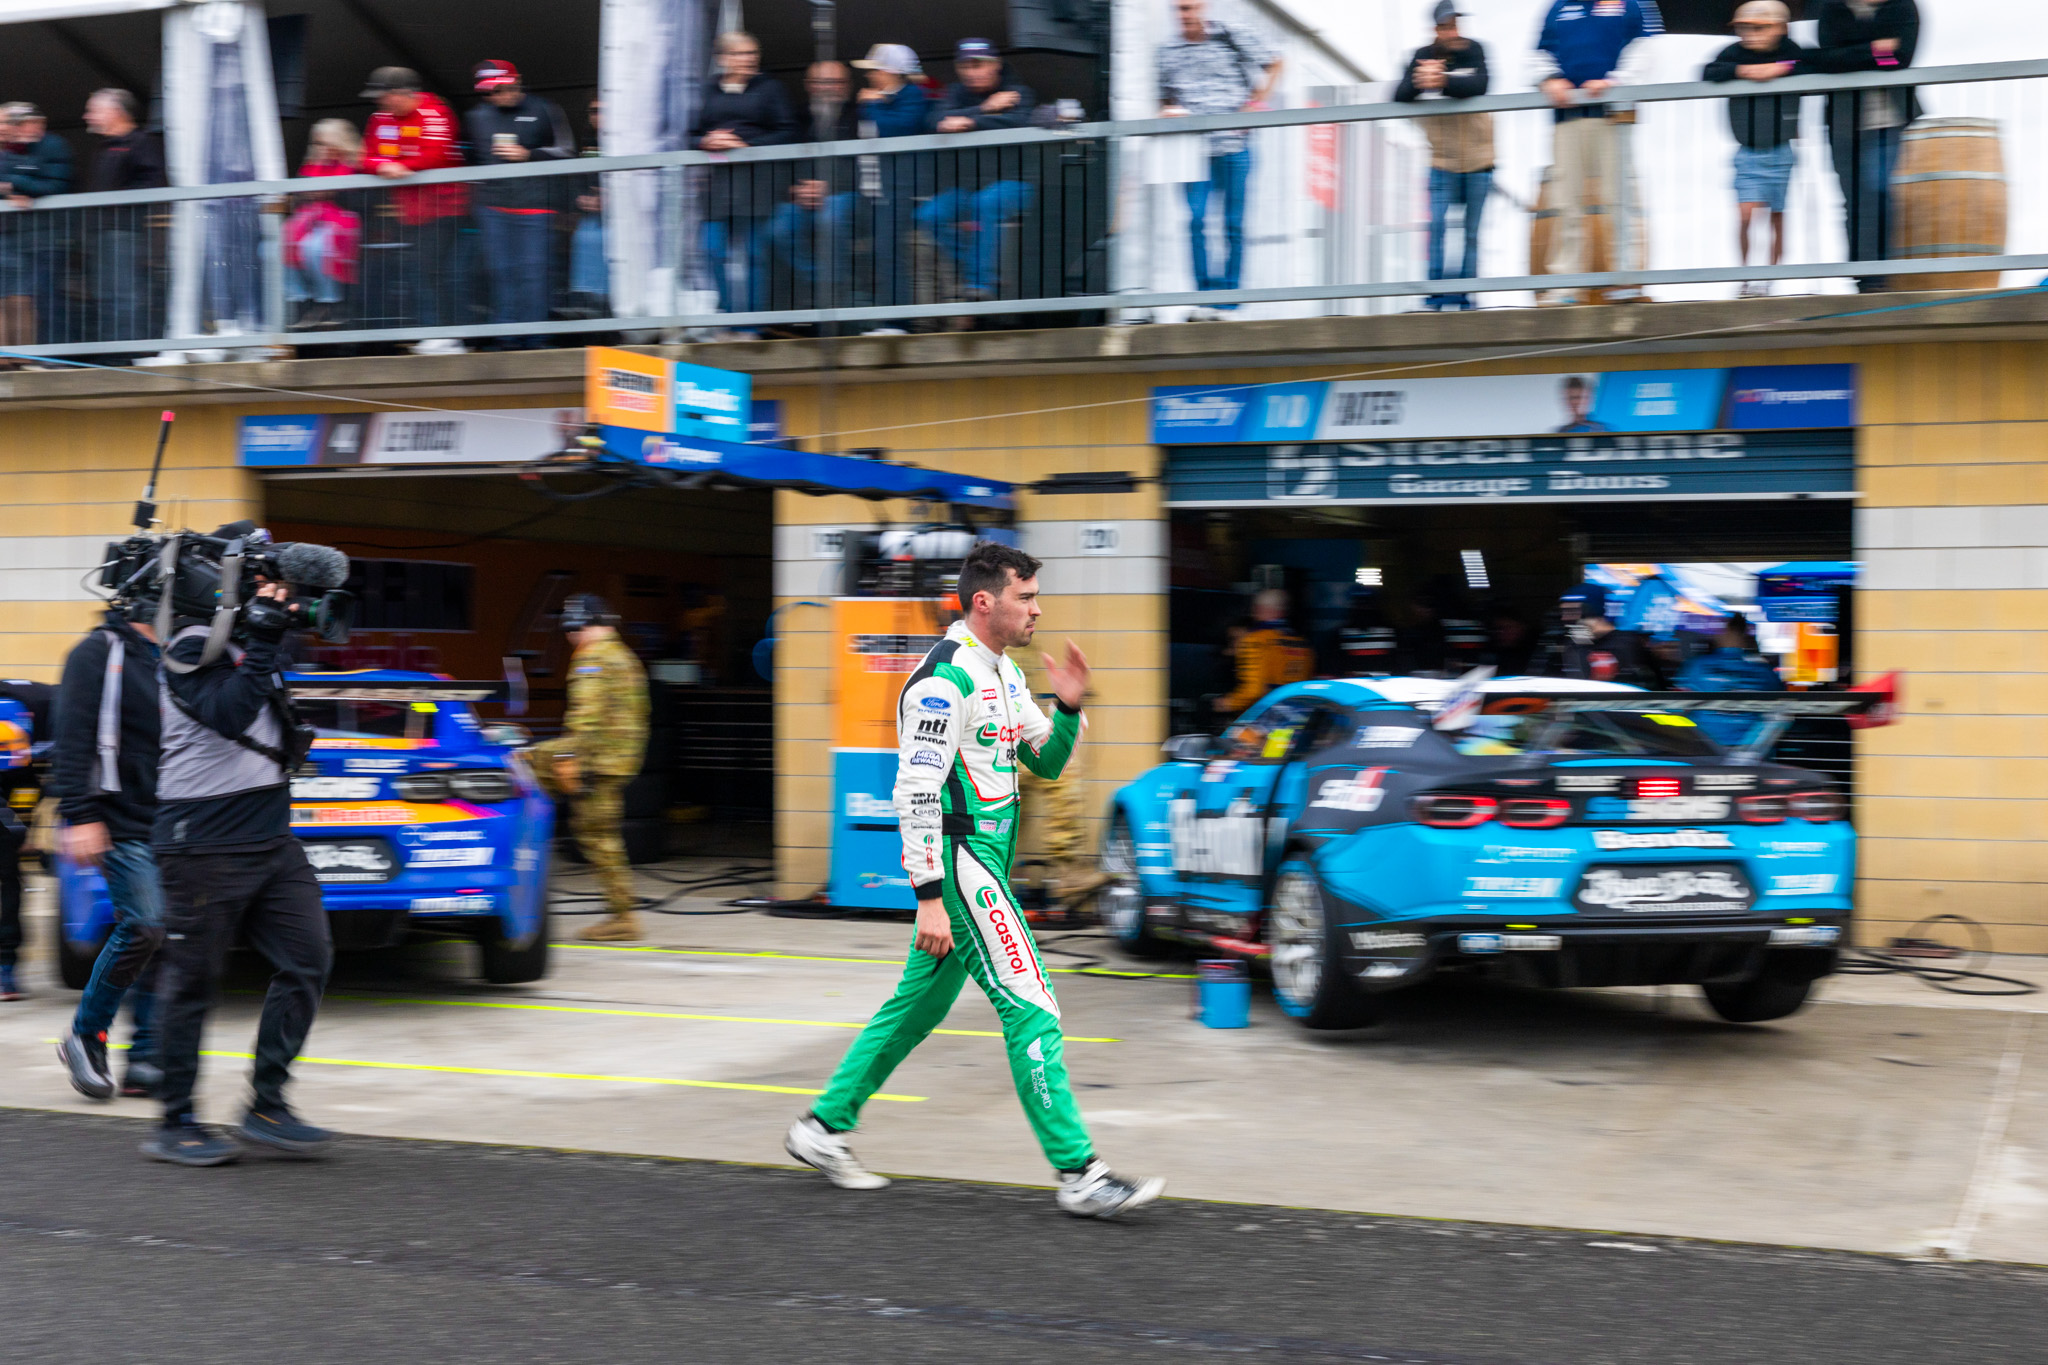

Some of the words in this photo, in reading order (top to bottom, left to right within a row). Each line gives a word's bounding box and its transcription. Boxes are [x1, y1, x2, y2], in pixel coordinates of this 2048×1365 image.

[1387, 473, 1532, 498] Garage
[1546, 470, 1672, 491] Doors
[917, 718, 948, 734] nti
[989, 909, 1028, 975] Castrol
